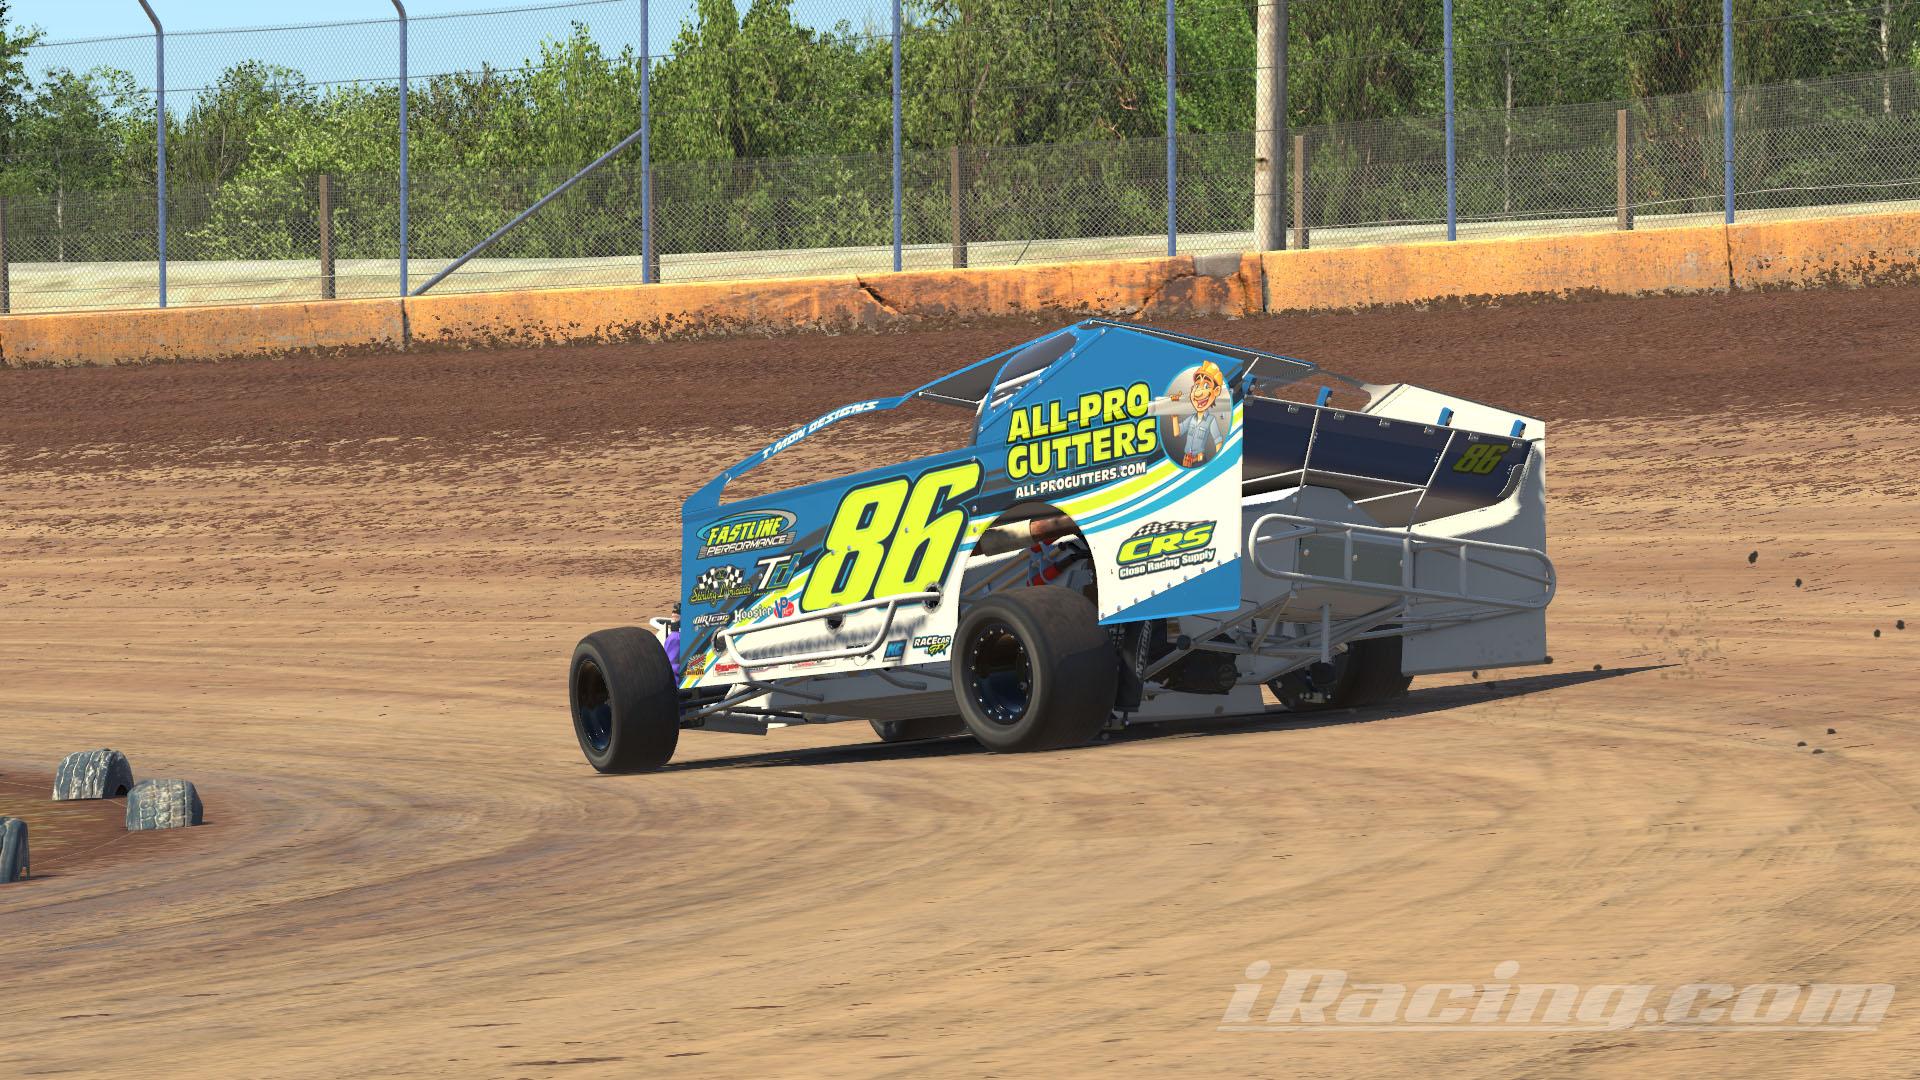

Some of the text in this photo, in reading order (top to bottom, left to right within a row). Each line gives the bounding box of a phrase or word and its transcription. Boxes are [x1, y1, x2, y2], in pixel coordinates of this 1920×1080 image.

[1007, 383, 1150, 443] ALL-PRO
[1007, 418, 1157, 479] GUTTERS
[1453, 443, 1509, 475] 86
[1015, 462, 1147, 498] ALL-PROGUTTERS.COM
[706, 517, 783, 547] FASTLINE
[706, 534, 787, 556] PERFORMANCE
[801, 461, 982, 612] 86
[1118, 525, 1213, 563] CRS
[1119, 548, 1216, 578] Close Racing Supply
[734, 606, 772, 623] Hoosier
